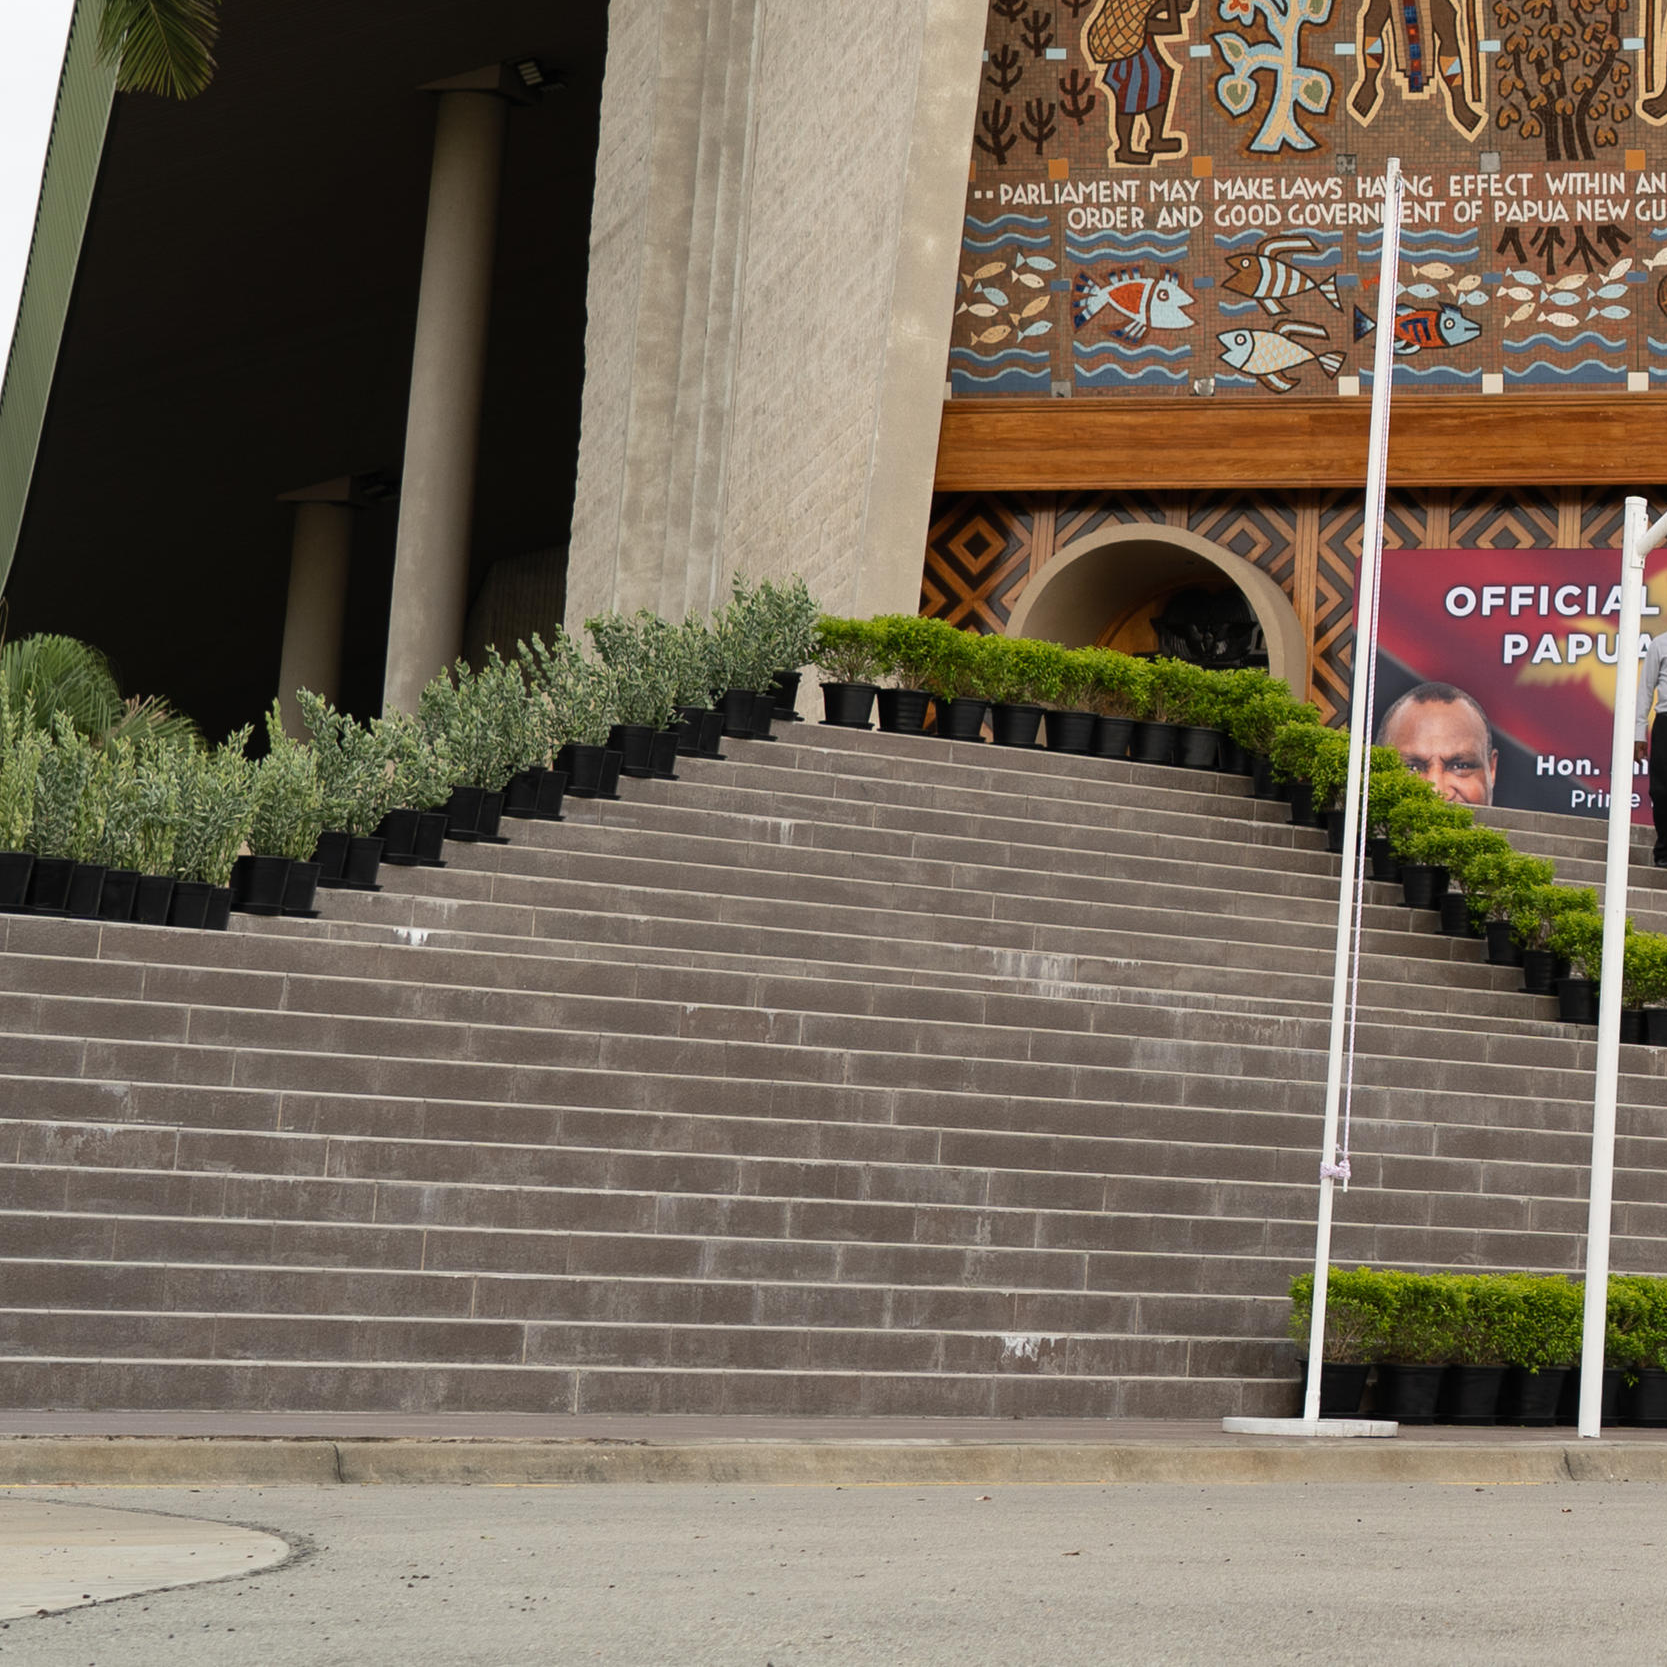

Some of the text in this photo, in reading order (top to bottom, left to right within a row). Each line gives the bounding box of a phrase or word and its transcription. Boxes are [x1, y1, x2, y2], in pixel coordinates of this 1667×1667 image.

[1150, 179, 1201, 202] MAY
[1213, 176, 1276, 200] MAKE
[1281, 176, 1343, 200] LAWS
[1357, 176, 1433, 198] HANG
[1450, 173, 1534, 197] EFFECT
[1545, 172, 1625, 196] WITHIN
[1067, 206, 1145, 229] ORDER
[1156, 206, 1204, 228] AND
[1214, 203, 1282, 226] GOOD
[1287, 201, 1446, 226] GOVERNENT
[1453, 200, 1483, 222] OF
[1494, 199, 1570, 223] PAPUA
[1576, 198, 1630, 221] NEW
[1445, 585, 1660, 617] OFFICIAL
[1536, 755, 1600, 776] Hon.
[1571, 789, 1641, 808] Prie
